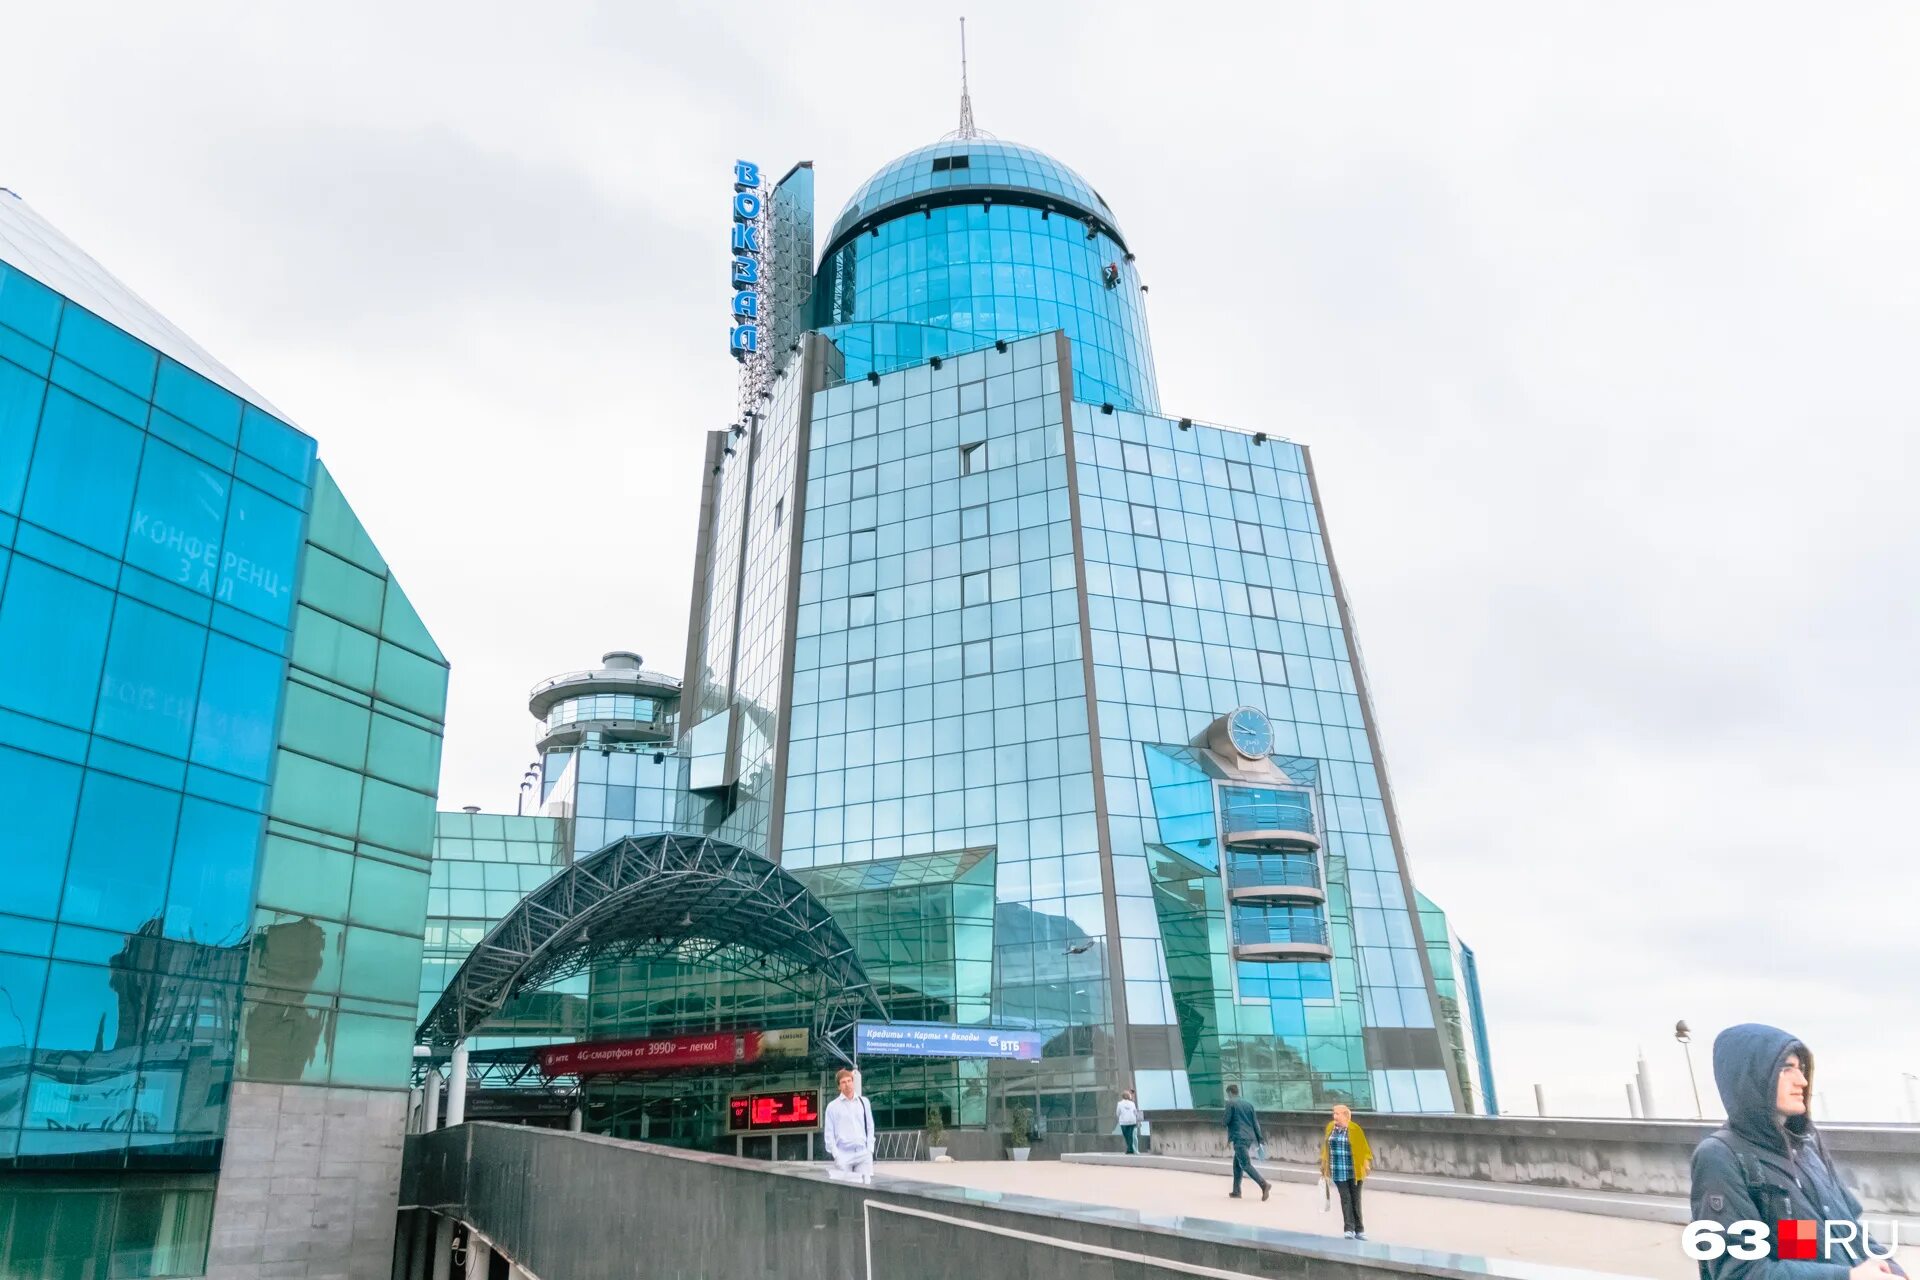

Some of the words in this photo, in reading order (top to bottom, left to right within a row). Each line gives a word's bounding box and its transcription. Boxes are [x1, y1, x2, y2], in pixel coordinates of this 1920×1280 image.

[732, 159, 760, 353] ВОКЗАЛ
[134, 510, 290, 598] КОНФЕРЕНЦ-
[177, 558, 234, 601] ЗАЛ
[577, 1048, 633, 1060] 4G-смартфон
[635, 1048, 645, 1056] от
[689, 1040, 718, 1052] легко!
[866, 1029, 904, 1039] Кредиты
[914, 1031, 941, 1041] Карты
[951, 1032, 980, 1041] Вклады
[1000, 1040, 1020, 1052] ВТБ
